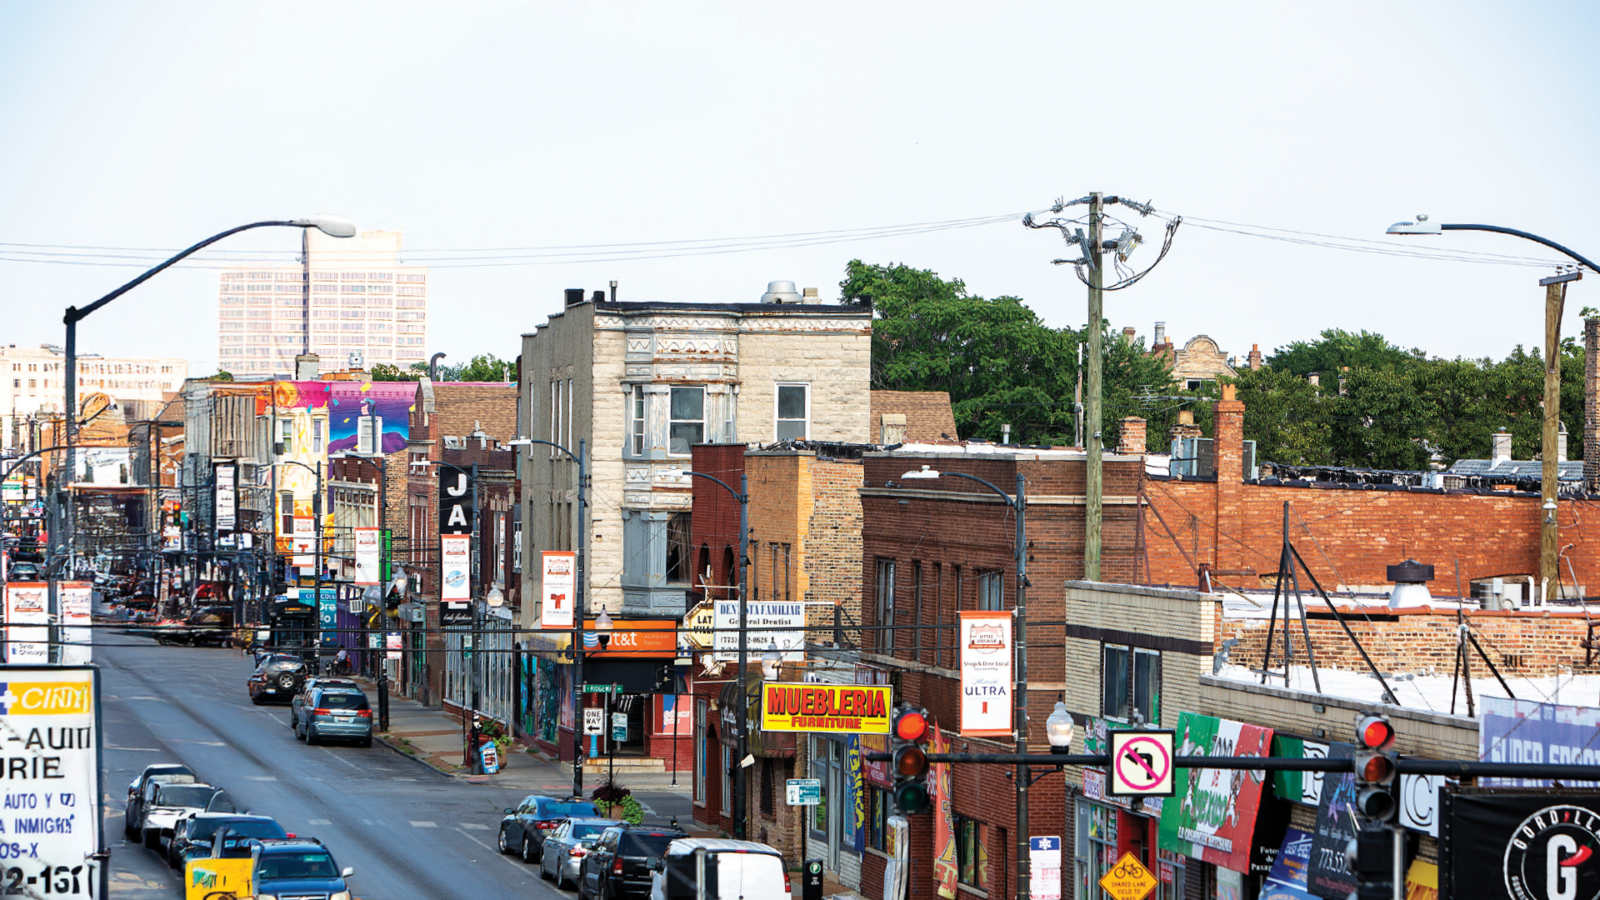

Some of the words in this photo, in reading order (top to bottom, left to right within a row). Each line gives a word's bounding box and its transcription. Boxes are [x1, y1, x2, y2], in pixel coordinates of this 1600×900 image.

[761, 605, 801, 616] FAMILIAR
[590, 685, 612, 693] RIDGEWA
[965, 686, 1006, 695] ULTRA
[767, 687, 887, 718] MUEBLERIA
[791, 717, 862, 730] FURNITURE
[4, 793, 37, 809] AUTO
[44, 793, 53, 808] Y
[1547, 834, 1577, 900] G
